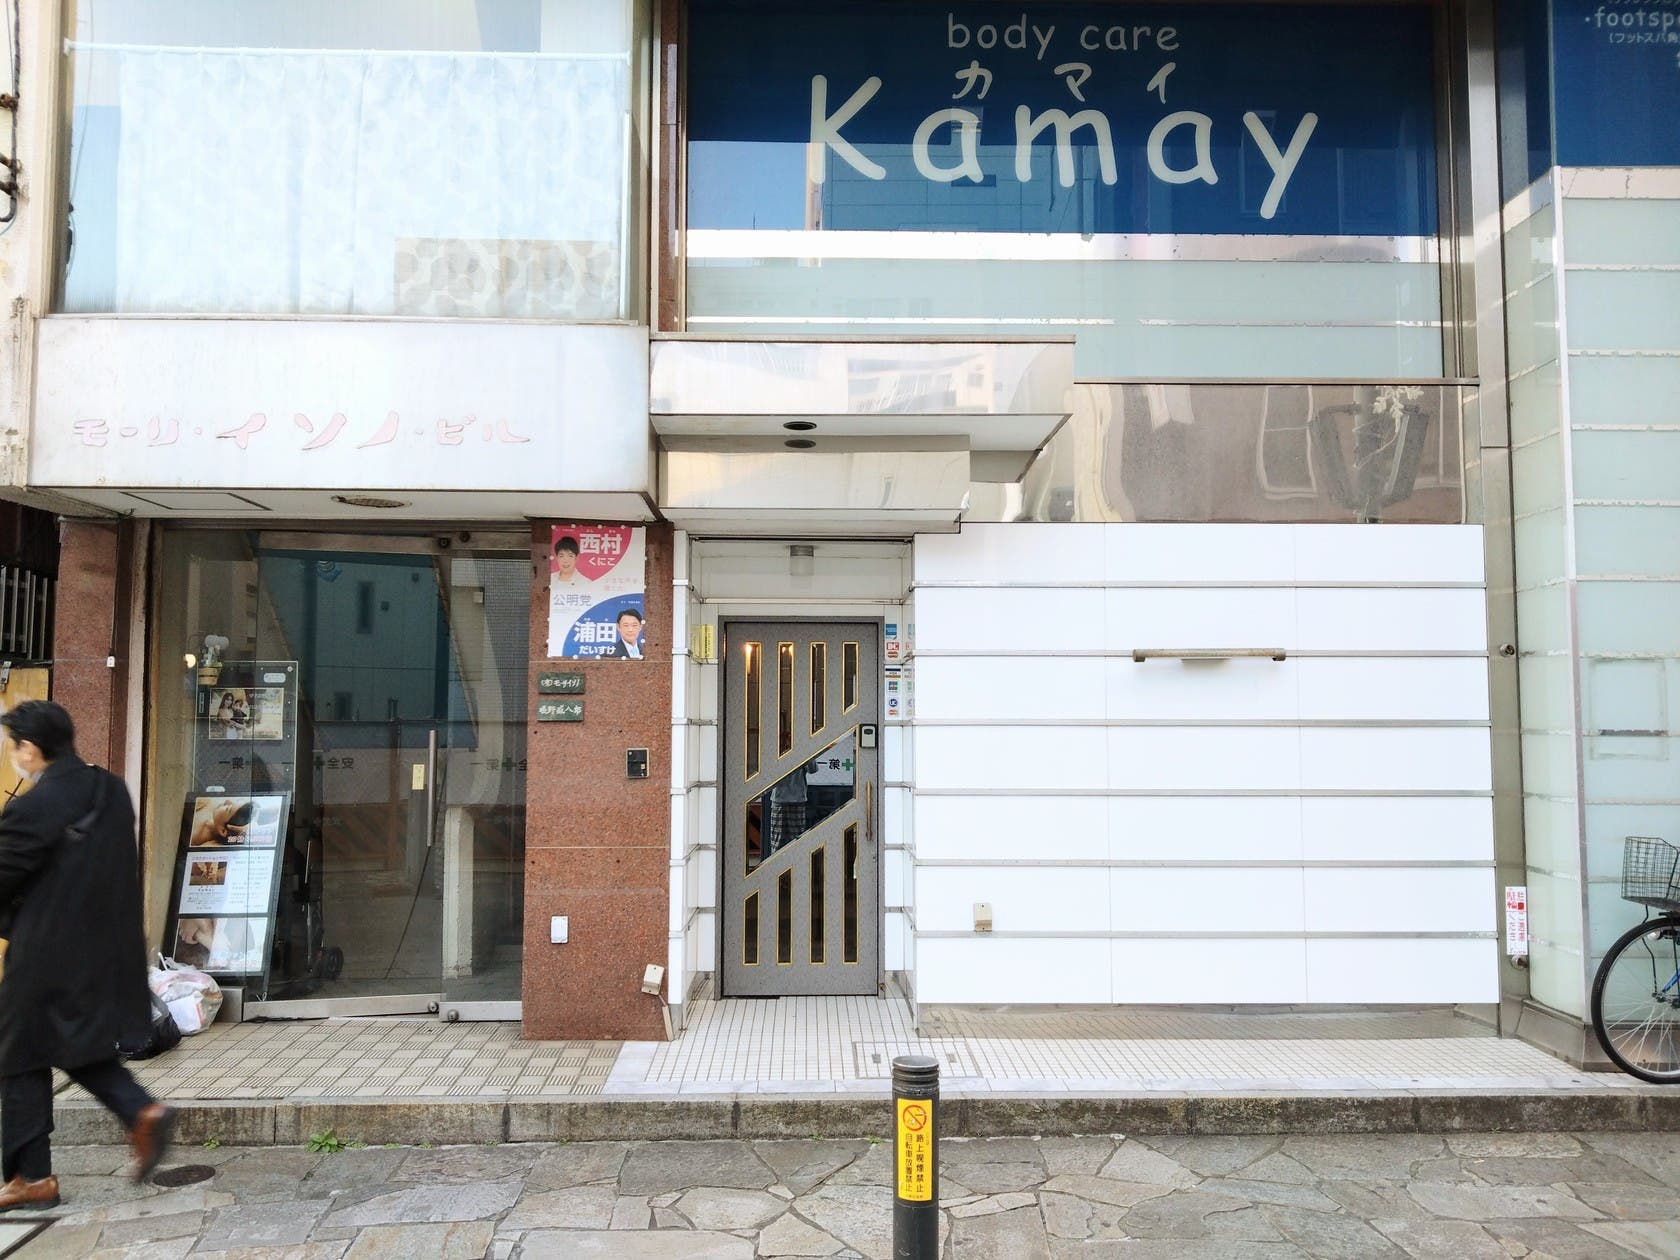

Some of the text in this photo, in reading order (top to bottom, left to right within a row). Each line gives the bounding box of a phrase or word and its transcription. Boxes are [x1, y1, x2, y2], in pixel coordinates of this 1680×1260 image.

[948, 13, 1180, 60] body care
[952, 60, 1177, 104] カマイ
[810, 74, 1318, 220] Kamay
[579, 533, 622, 555] 西村
[588, 557, 616, 566] くにこ
[553, 594, 592, 607] 公明党
[573, 621, 617, 643] 浦田
[578, 645, 617, 655] だいすけ
[916, 1133, 925, 1193] 路上喫煙禁止
